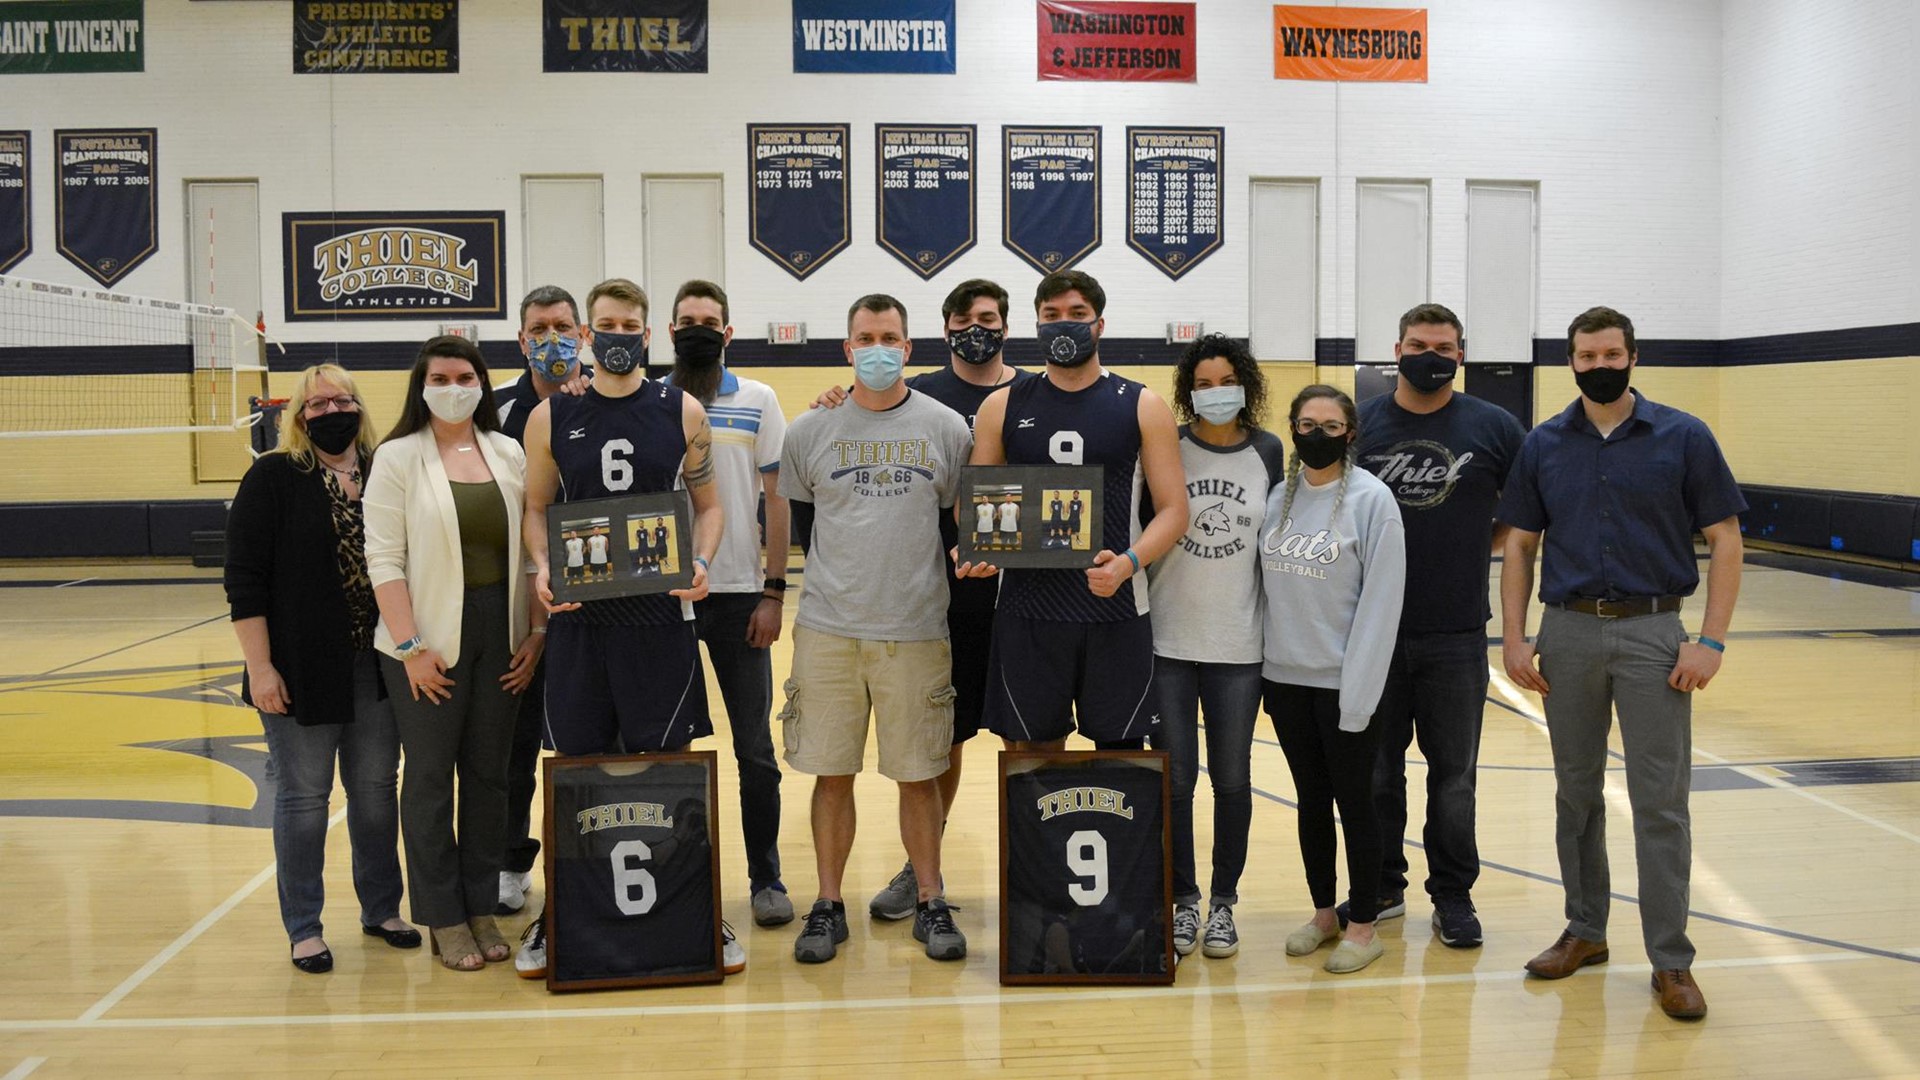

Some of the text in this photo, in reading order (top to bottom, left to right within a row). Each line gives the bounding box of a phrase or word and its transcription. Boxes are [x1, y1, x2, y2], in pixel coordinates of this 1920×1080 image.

[308, 2, 453, 20] PRESIDENTS'
[1050, 13, 1185, 36] WASHINGTON
[0, 20, 138, 53] AINT VINCENT
[321, 26, 431, 44] ATHLETIC
[560, 17, 692, 51] THIEL
[802, 20, 946, 51] WESTMINSTER
[1280, 26, 1422, 60] WAYNESBURG
[304, 50, 448, 68] CONFERENCE
[1070, 47, 1181, 69] JEFFERSON
[70, 138, 141, 150] FOOTBALL
[758, 132, 840, 144] MEN'S GOLF
[1136, 135, 1215, 147] WRESTLING
[63, 150, 148, 165] CHAMPIONSHIPS
[756, 145, 842, 160] CHAMPIONSHIPS
[884, 145, 969, 160] CHAMPIONSHIPS
[1010, 147, 1094, 162] CHAMPIONSHIPS
[1134, 148, 1216, 163] CHAMPIONSHIPS
[92, 164, 120, 174] PAC
[786, 158, 813, 168] PAC
[914, 158, 940, 168] PAC
[1040, 160, 1066, 170] PAC
[1163, 160, 1188, 170] PAC
[64, 176, 150, 186] 1967 1972 2005
[757, 170, 843, 180] 1970 1971 1972
[884, 170, 969, 180] 1992 1996 1998
[1010, 172, 1094, 181] 1991 1996 1997
[1134, 172, 1216, 181] 1963 1964 1991
[757, 180, 812, 188] 1973 1975
[884, 180, 939, 188] 2003 2004
[1010, 181, 1034, 189] 1998
[1134, 182, 1216, 190] 1992 1993 1994
[1193, 191, 1216, 199] 1998
[1134, 199, 1216, 208] 2000 2001 2002
[1134, 208, 1216, 217] 2003 2004 2005
[1134, 217, 1216, 225] 2006 2007 2008
[1134, 226, 1216, 234] 2009 2012 2015
[1164, 235, 1188, 244] 2016
[314, 227, 478, 286] THIEL
[321, 266, 472, 301] COLLEGE
[778, 325, 796, 340] EXIT
[1177, 324, 1196, 339] EXIT
[1048, 430, 1084, 465] 9
[832, 439, 936, 472] THIEL
[601, 438, 634, 492] 6
[1365, 452, 1473, 483] Thiel
[855, 470, 912, 484] 18 66
[853, 486, 912, 497] COLLEGE
[1186, 480, 1246, 506] THIEL
[1398, 485, 1436, 497] College
[1237, 515, 1252, 527] 66
[1264, 518, 1341, 564] Cats
[1264, 560, 1327, 580] VOLLEYBALL
[1038, 787, 1134, 821] THIEL
[577, 802, 674, 835] THIEL
[1066, 830, 1108, 906] 9
[610, 840, 657, 916] 6
